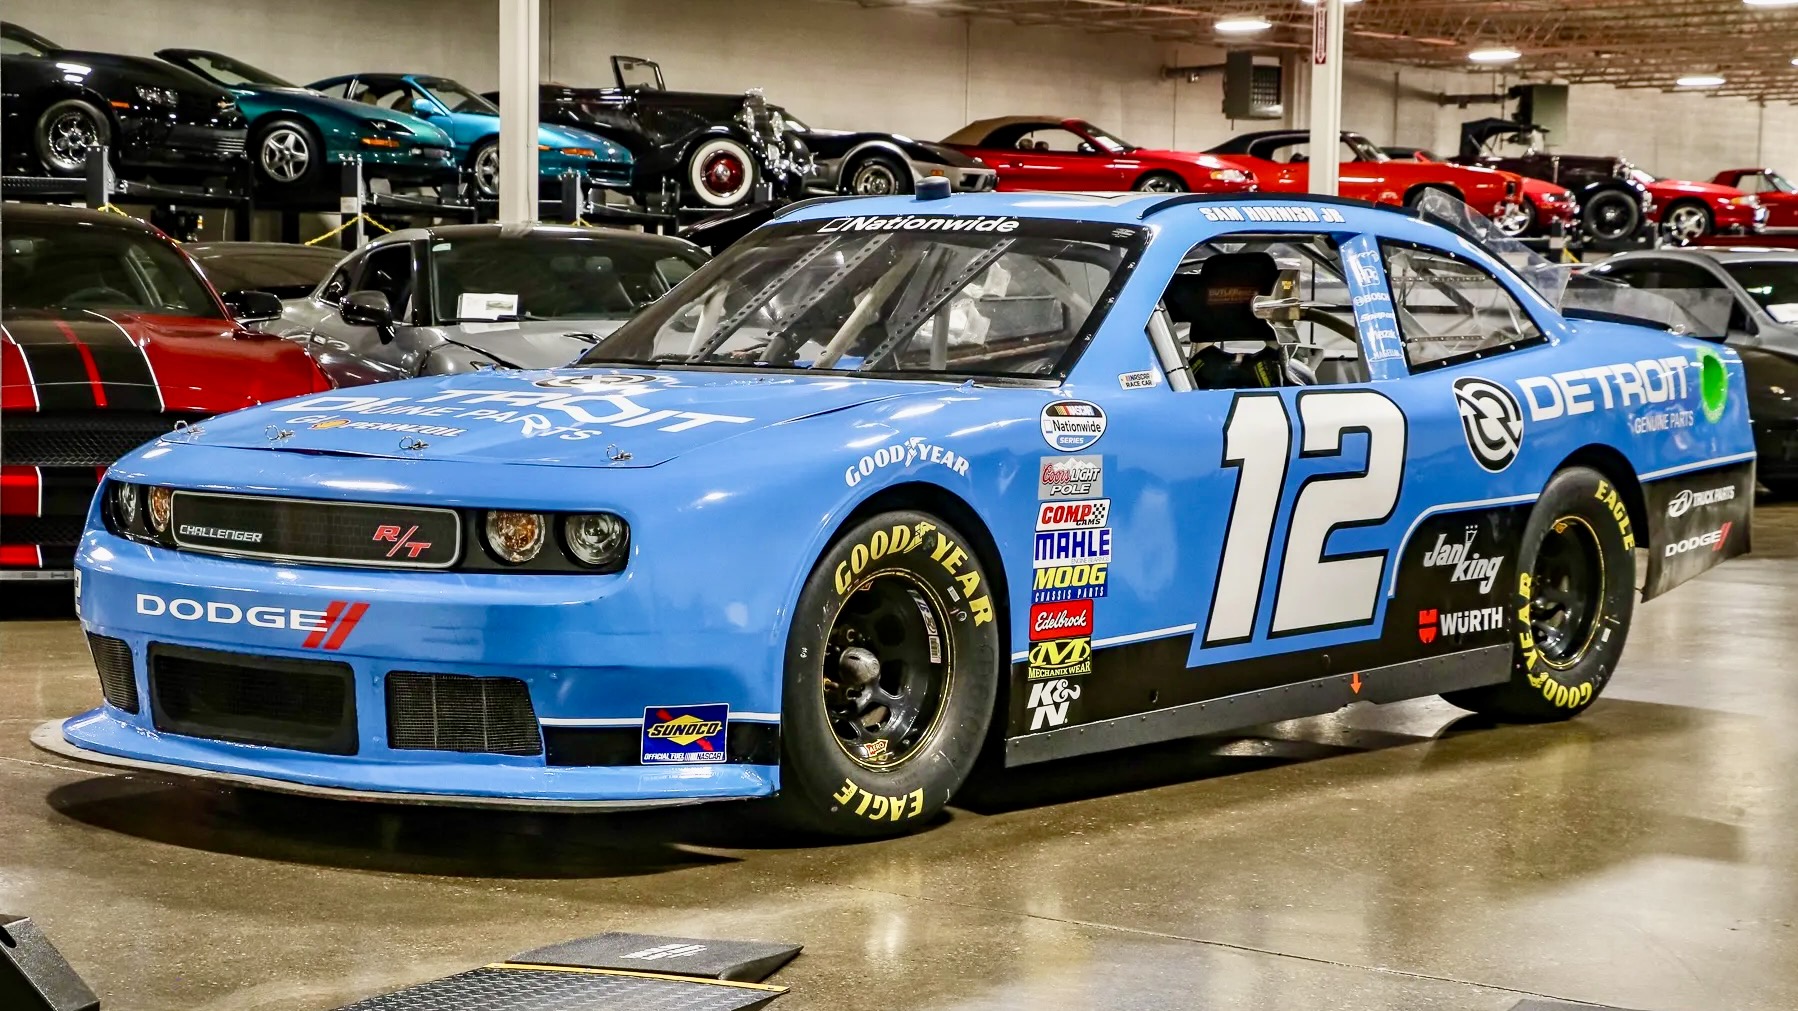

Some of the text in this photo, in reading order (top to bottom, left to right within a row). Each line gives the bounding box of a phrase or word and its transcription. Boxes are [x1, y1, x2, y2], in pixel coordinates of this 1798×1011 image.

[842, 215, 1020, 233] Nationwide
[1198, 207, 1245, 222] SAM
[1320, 207, 1346, 223] JR
[1515, 356, 1690, 422] DETROIT
[338, 422, 468, 437] PENNZOIL
[1053, 420, 1102, 433] Nationwide
[1635, 410, 1694, 434] GENUINE PARTS
[1070, 468, 1101, 482] LIGHT
[1050, 483, 1091, 496] POLE
[1041, 504, 1092, 525] COMP
[1200, 390, 1408, 650] 12
[1595, 480, 1634, 551] EAGLE
[179, 524, 432, 558] CHALLENGER R/T
[1034, 529, 1110, 561] MAHLE
[1664, 530, 1723, 557] DODGE
[1033, 563, 1108, 590] MOOG
[1035, 586, 1104, 603] CHASSIS PARTS
[135, 593, 330, 632] DODGE
[1034, 609, 1087, 632] Edelbrock
[1028, 661, 1091, 679] MECHANIX WEAR
[650, 722, 720, 737] SUNOCO
[644, 752, 723, 761] OFFICIAL FUEL NASCAR
[833, 778, 924, 821] EAGLE
